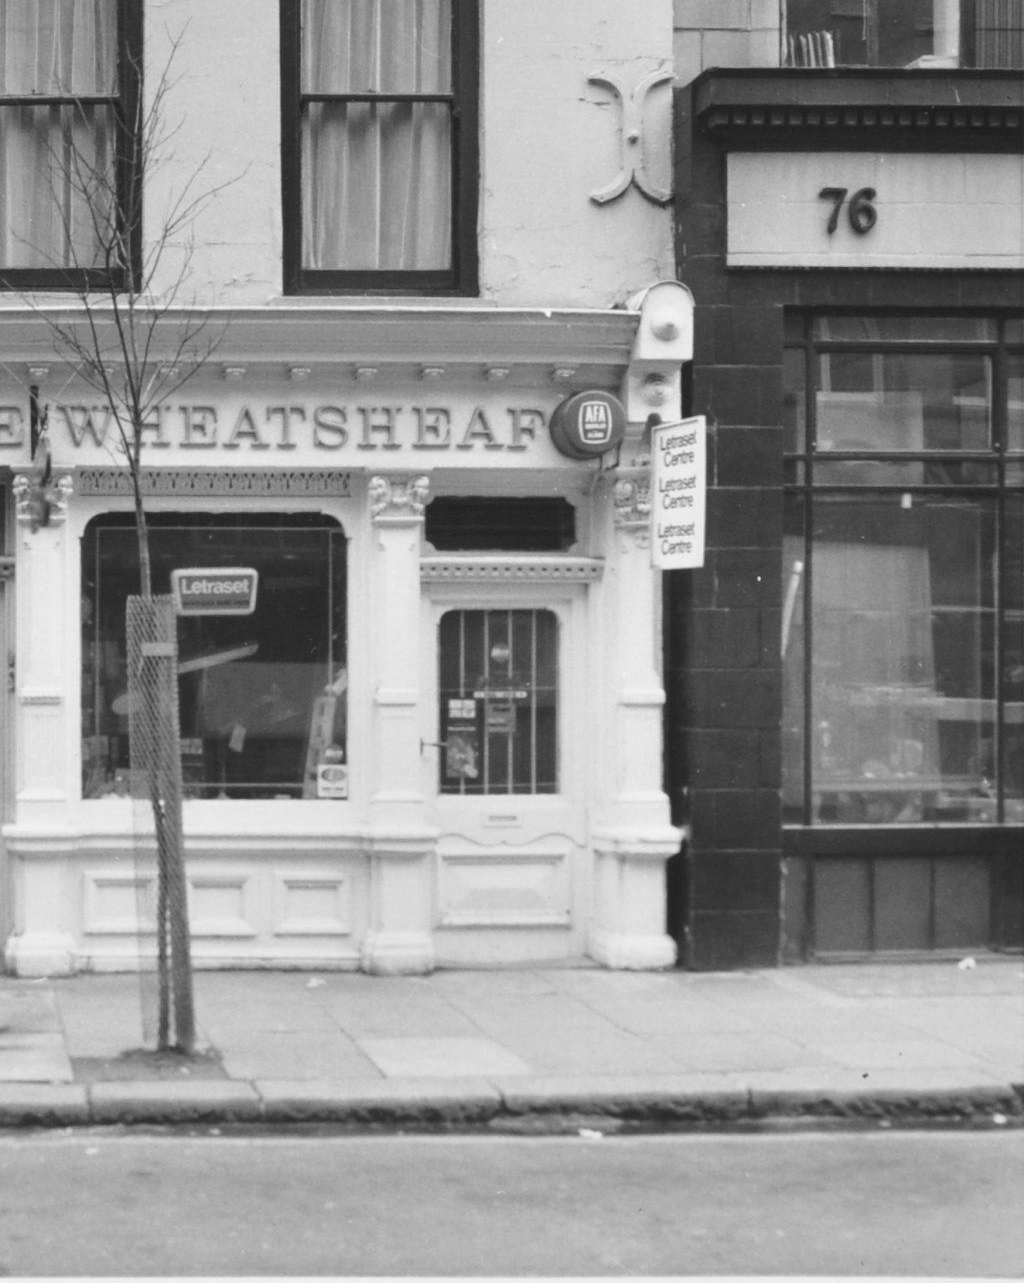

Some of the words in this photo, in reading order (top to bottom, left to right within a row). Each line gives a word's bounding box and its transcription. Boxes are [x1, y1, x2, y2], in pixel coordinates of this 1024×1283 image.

[818, 186, 878, 236] 76
[585, 405, 606, 423] AFA
[55, 403, 549, 453] WHEATSHEAF
[660, 431, 697, 451] Letraset
[663, 451, 695, 468] Centre
[658, 476, 697, 493] Letraset
[662, 493, 694, 510] Centre
[657, 522, 695, 539] Letraset
[660, 539, 693, 556] Centre
[181, 578, 250, 595] Letraset
